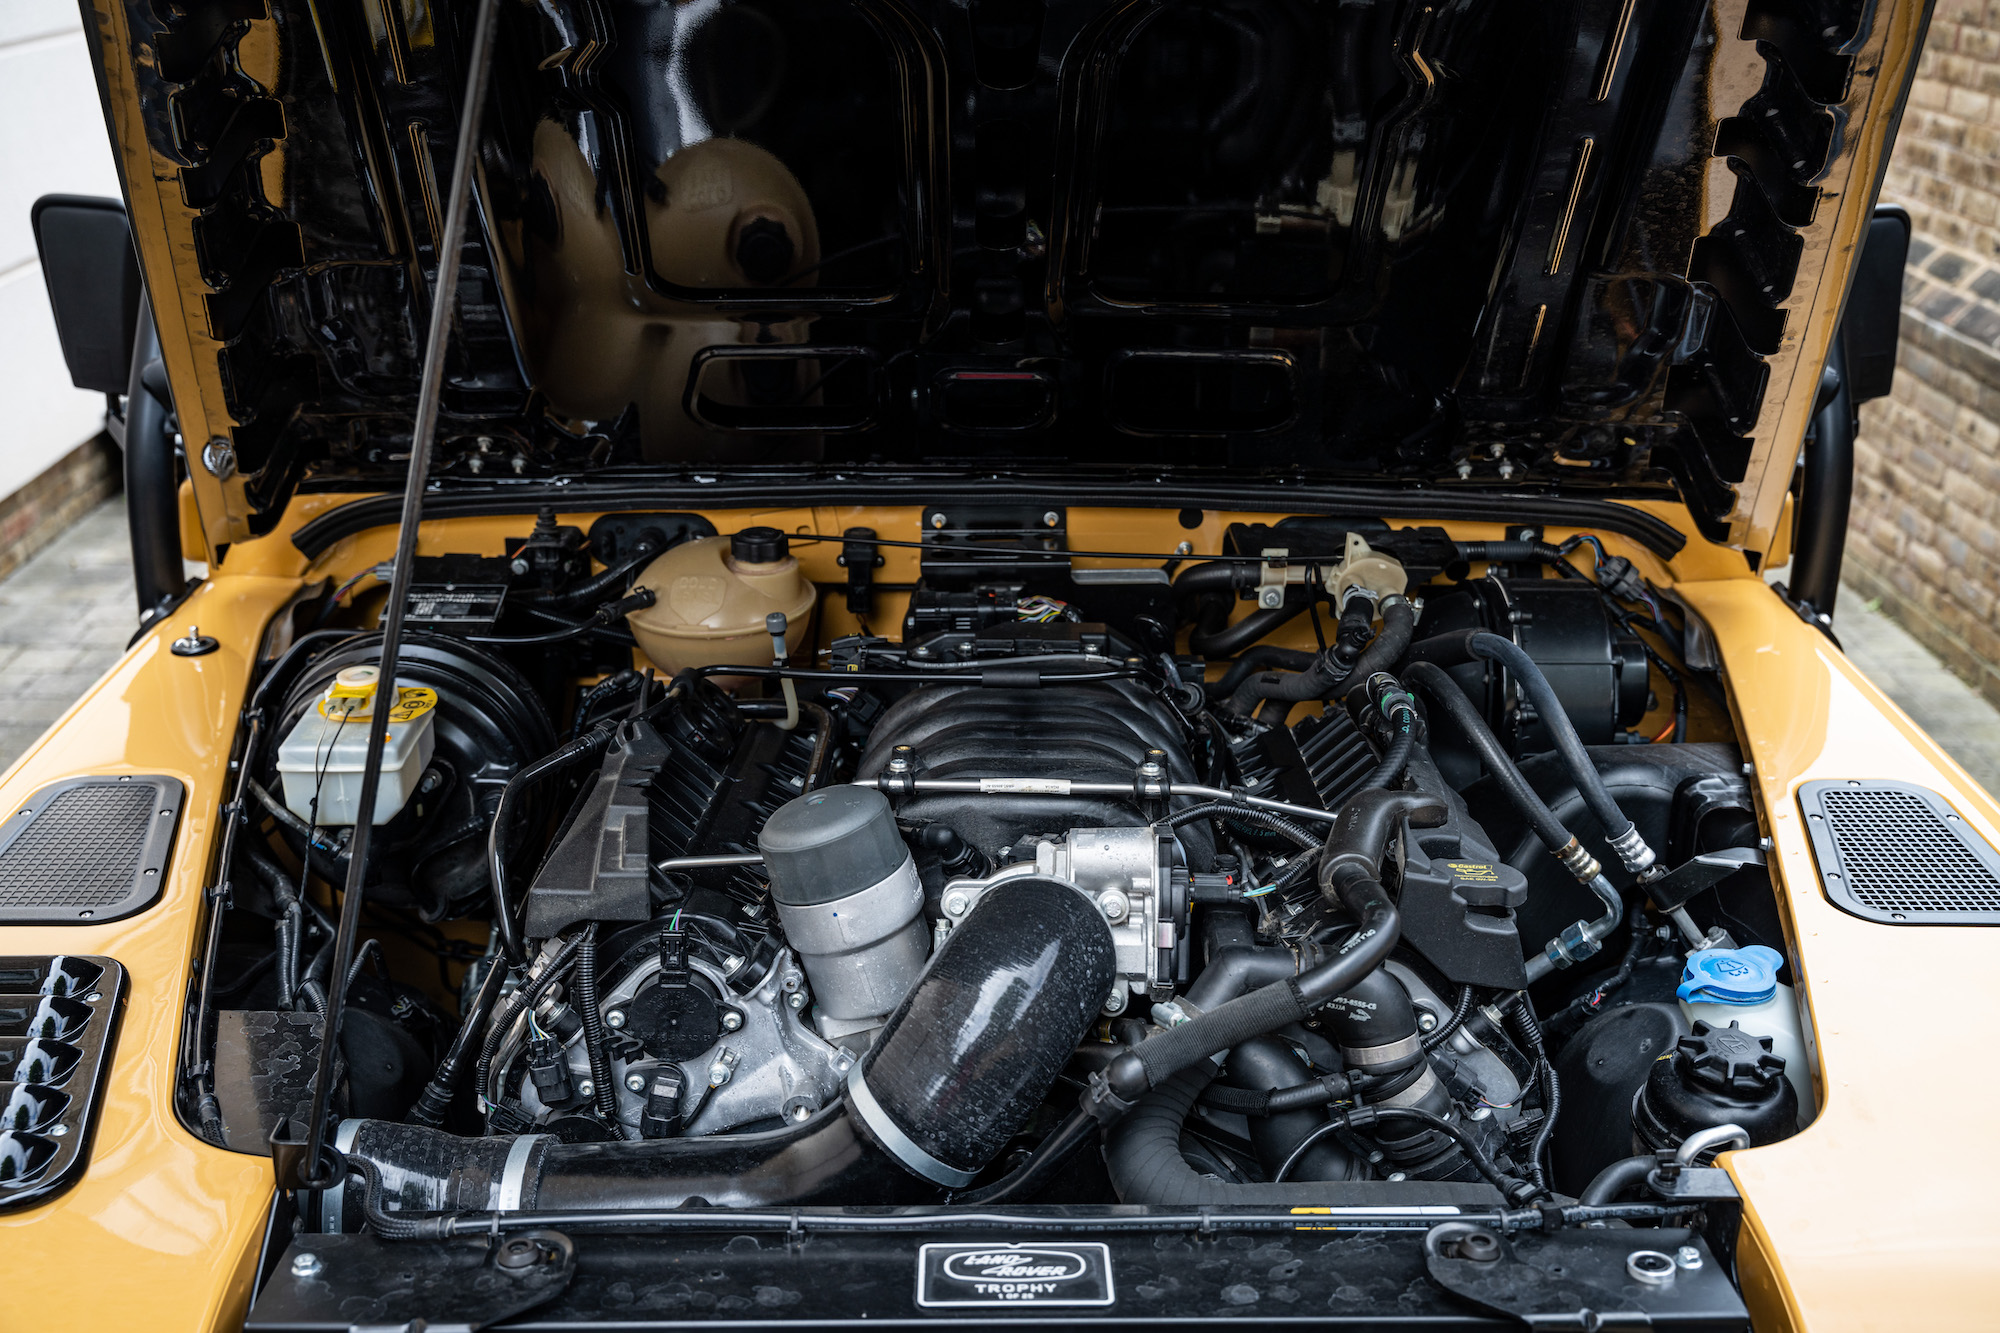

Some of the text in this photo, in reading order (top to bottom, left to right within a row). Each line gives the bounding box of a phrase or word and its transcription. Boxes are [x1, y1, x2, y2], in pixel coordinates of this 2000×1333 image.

[1717, 1034, 1750, 1054] ZF
[963, 1254, 1024, 1266] LAND
[993, 1265, 1068, 1277] ROVER
[974, 1283, 1057, 1293] TROPHY
